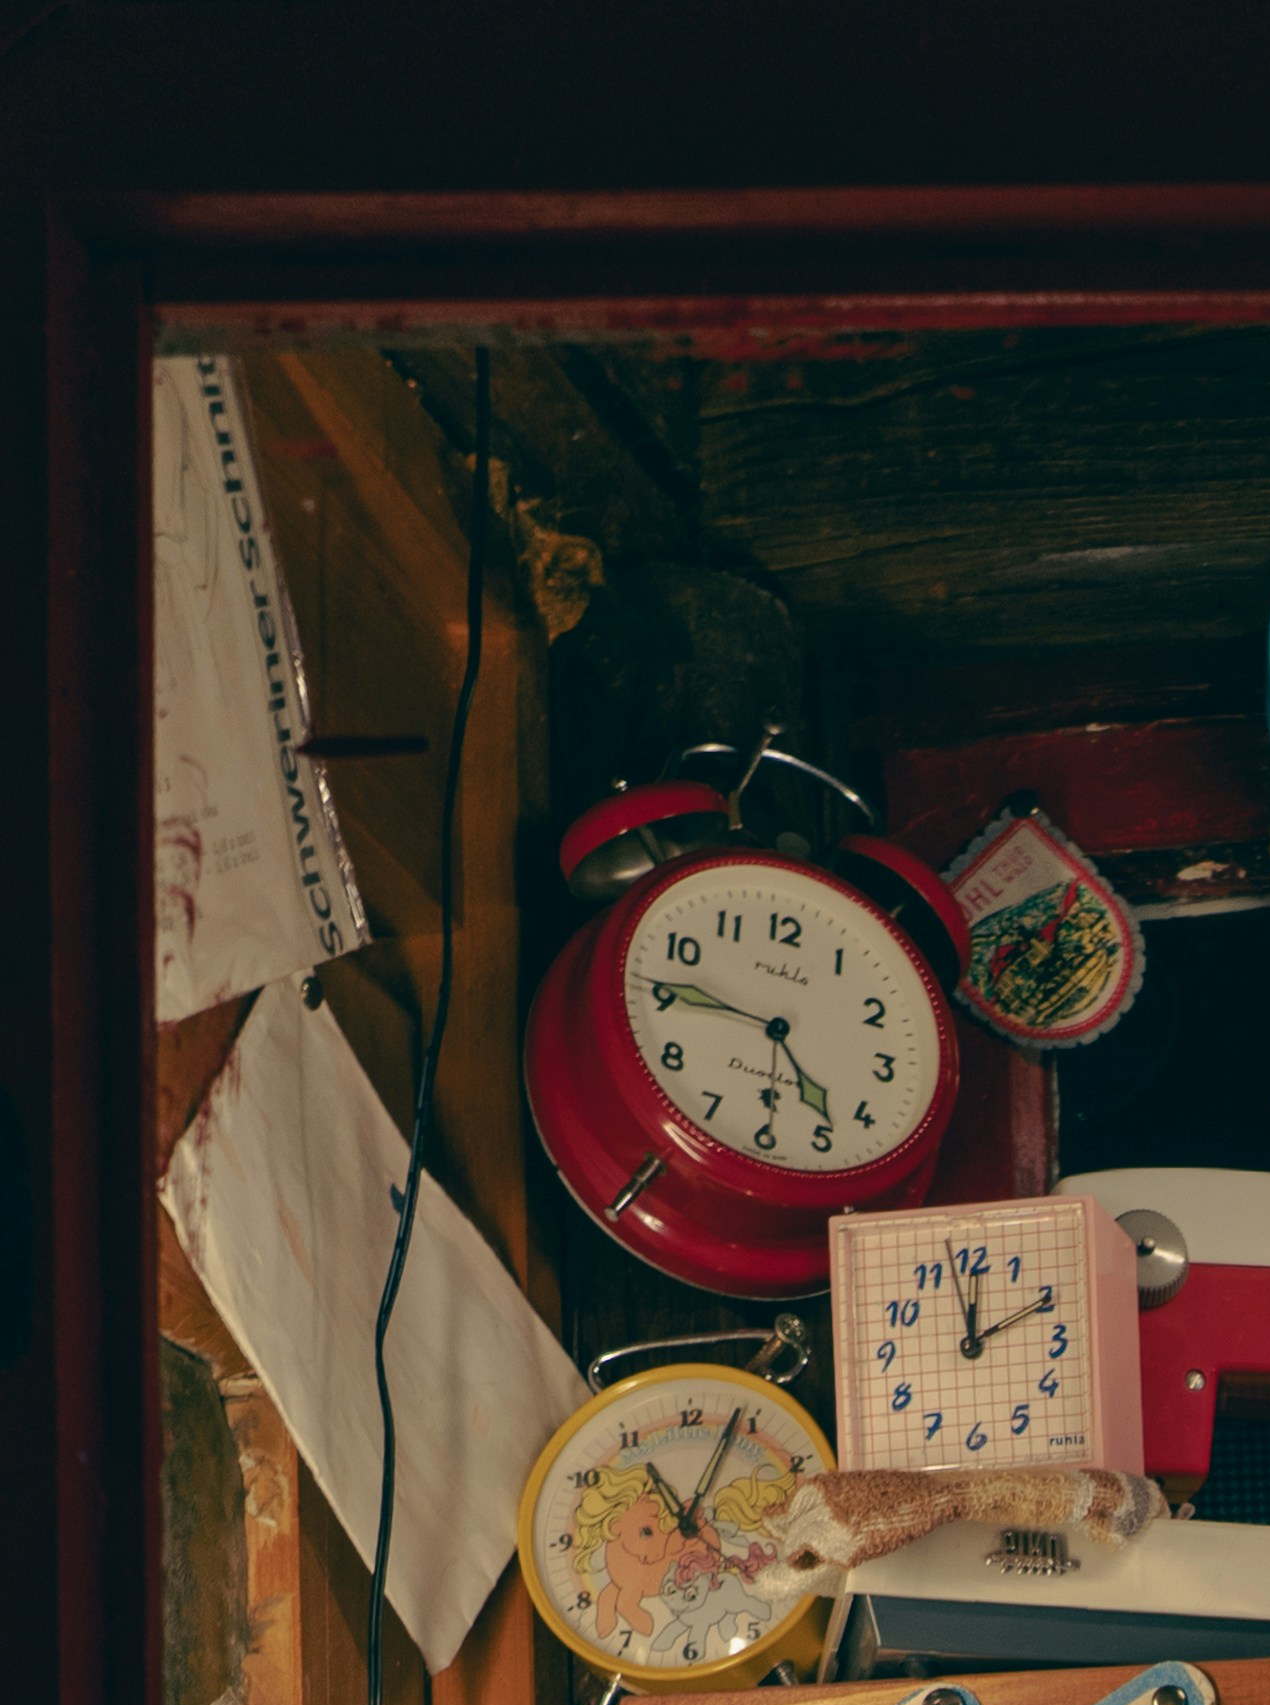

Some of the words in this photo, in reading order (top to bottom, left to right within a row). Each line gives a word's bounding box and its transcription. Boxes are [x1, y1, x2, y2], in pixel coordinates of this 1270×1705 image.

[717, 910, 742, 943] 11
[769, 913, 803, 948] 12
[666, 932, 702, 966] 10
[833, 948, 845, 976] 1
[652, 982, 679, 1012] 9
[863, 997, 887, 1029] 2
[660, 1042, 685, 1072] 8
[872, 1052, 897, 1083] 3
[701, 1090, 724, 1122] 7
[853, 1100, 877, 1130] 4
[754, 1123, 777, 1151] 6
[811, 1122, 834, 1153] 5
